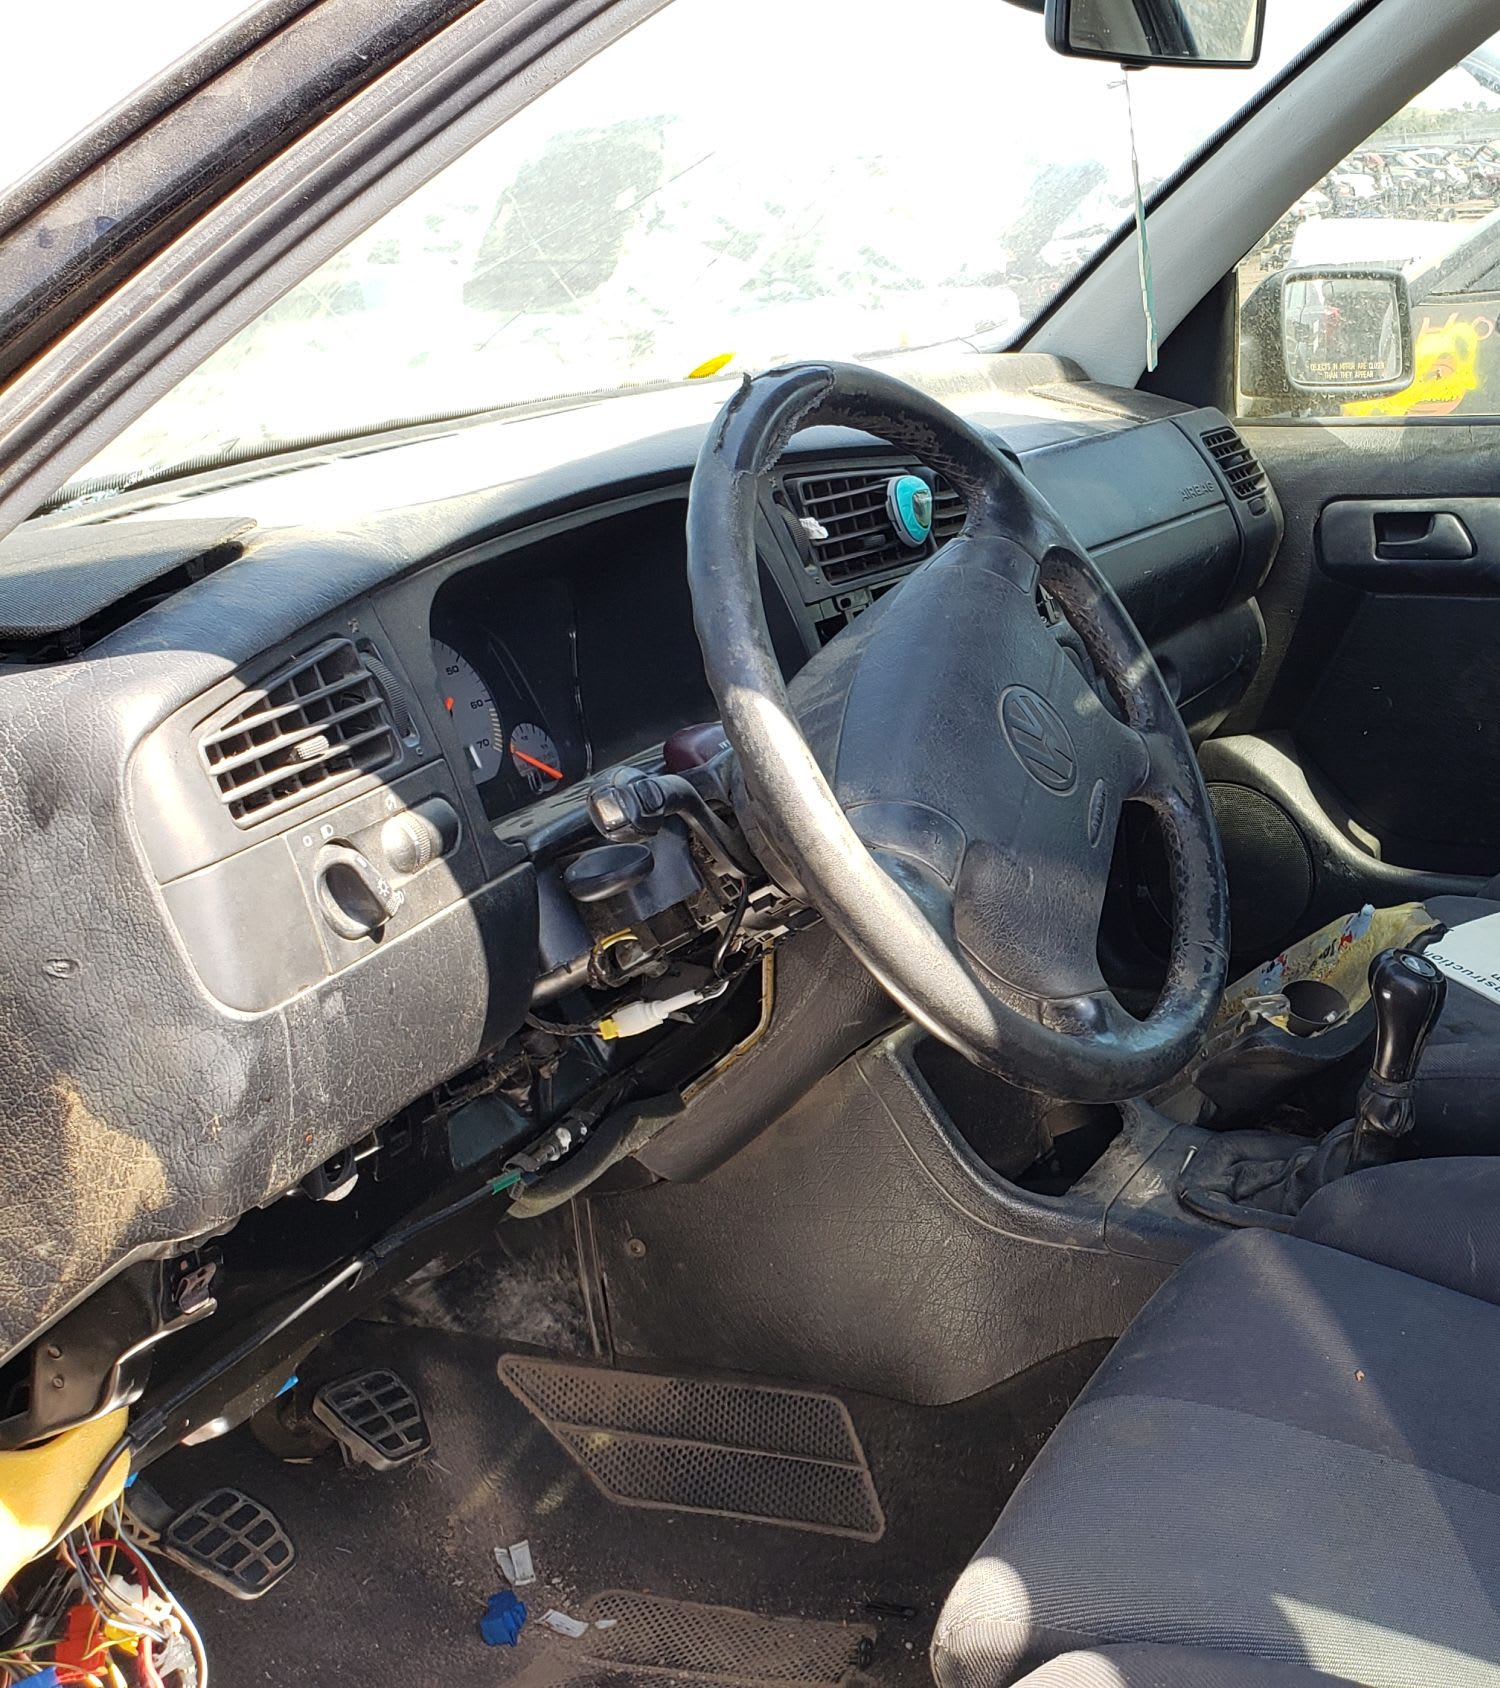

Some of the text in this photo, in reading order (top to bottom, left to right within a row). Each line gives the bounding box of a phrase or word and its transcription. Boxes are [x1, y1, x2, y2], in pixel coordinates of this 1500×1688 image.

[1180, 481, 1215, 502] AIRBAG
[446, 665, 460, 676] 50
[470, 699, 484, 710] 60
[476, 738, 490, 749] 70
